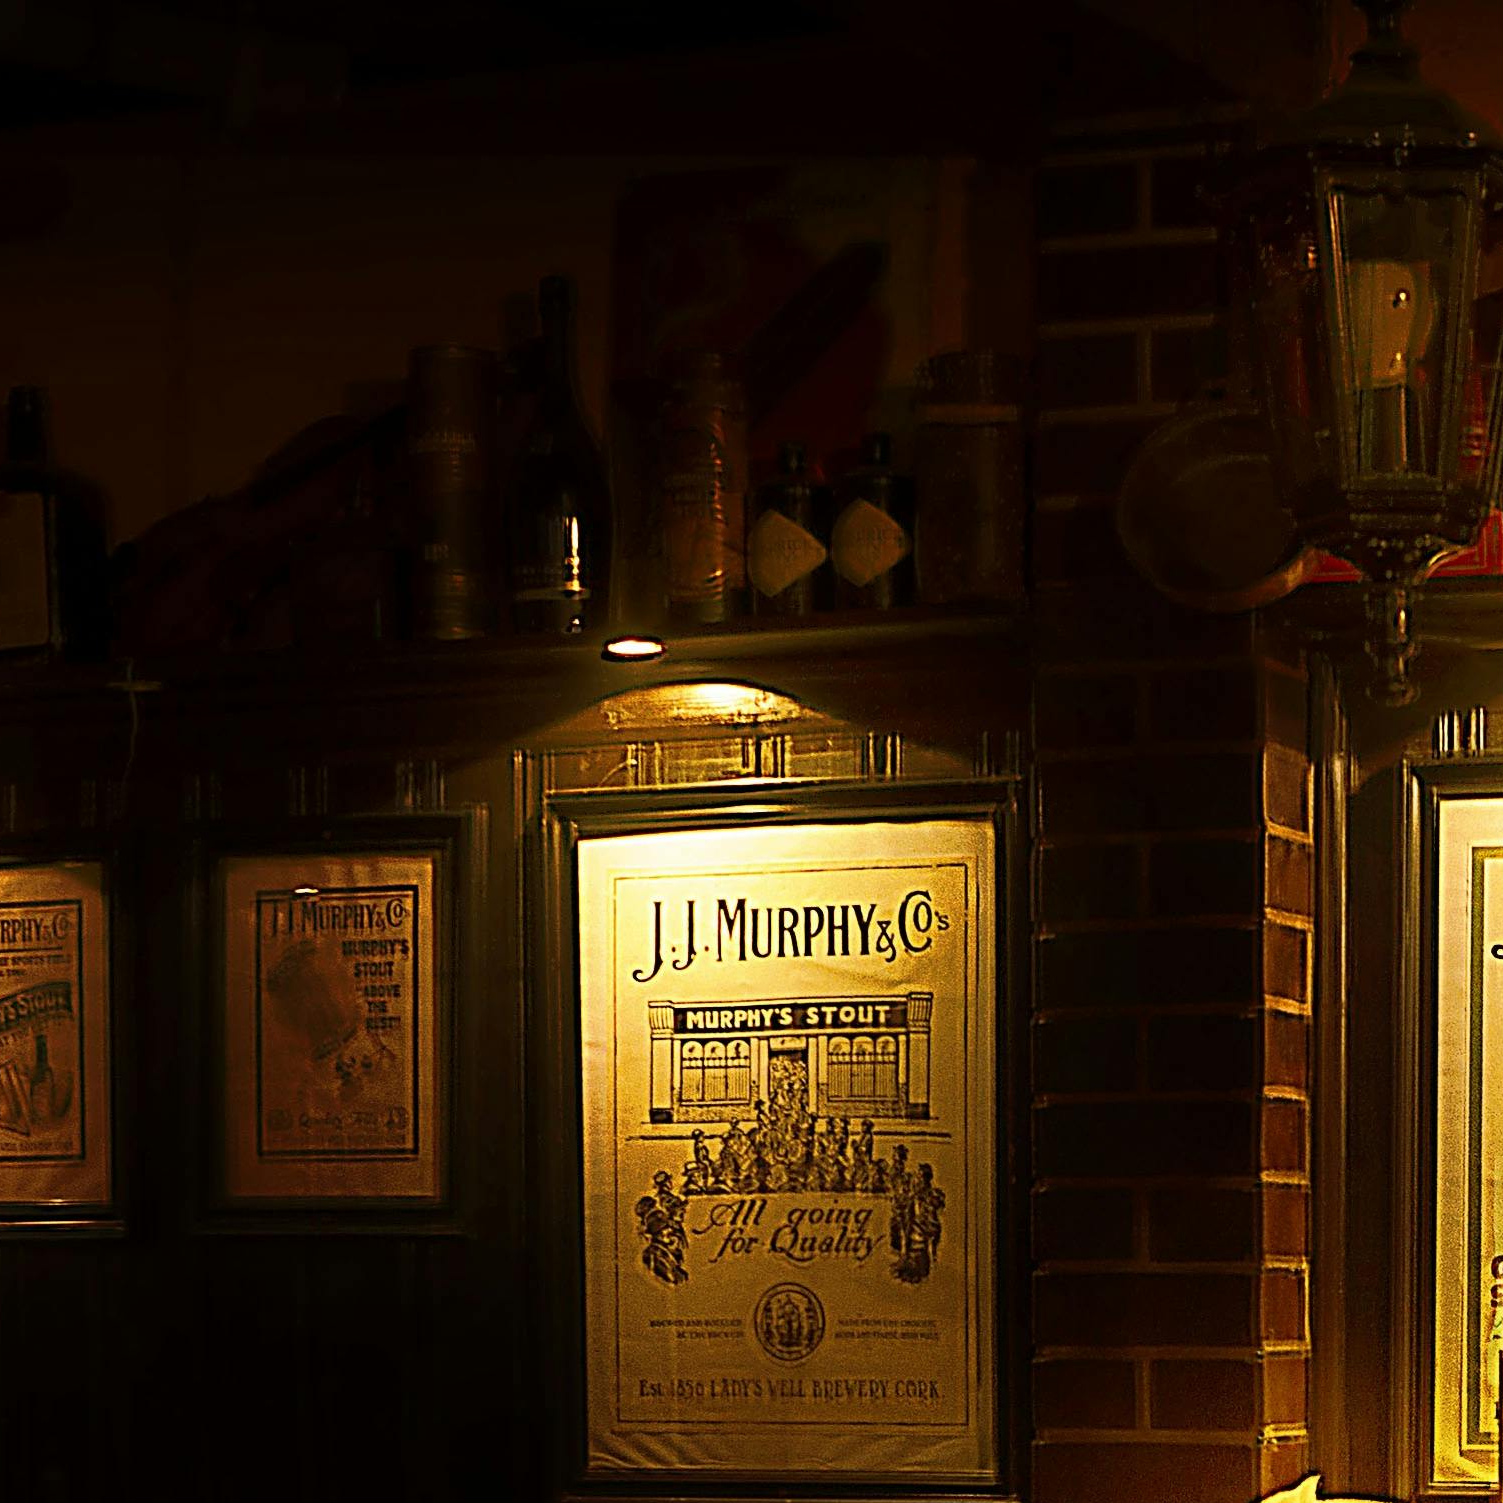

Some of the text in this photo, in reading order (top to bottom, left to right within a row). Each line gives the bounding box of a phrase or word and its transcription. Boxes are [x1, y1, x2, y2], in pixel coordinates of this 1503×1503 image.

[354, 961, 394, 977] STOUT
[685, 1004, 892, 1030] MURPHY'S STOUT
[692, 1198, 874, 1235] All going
[709, 1224, 887, 1264] for Quality
